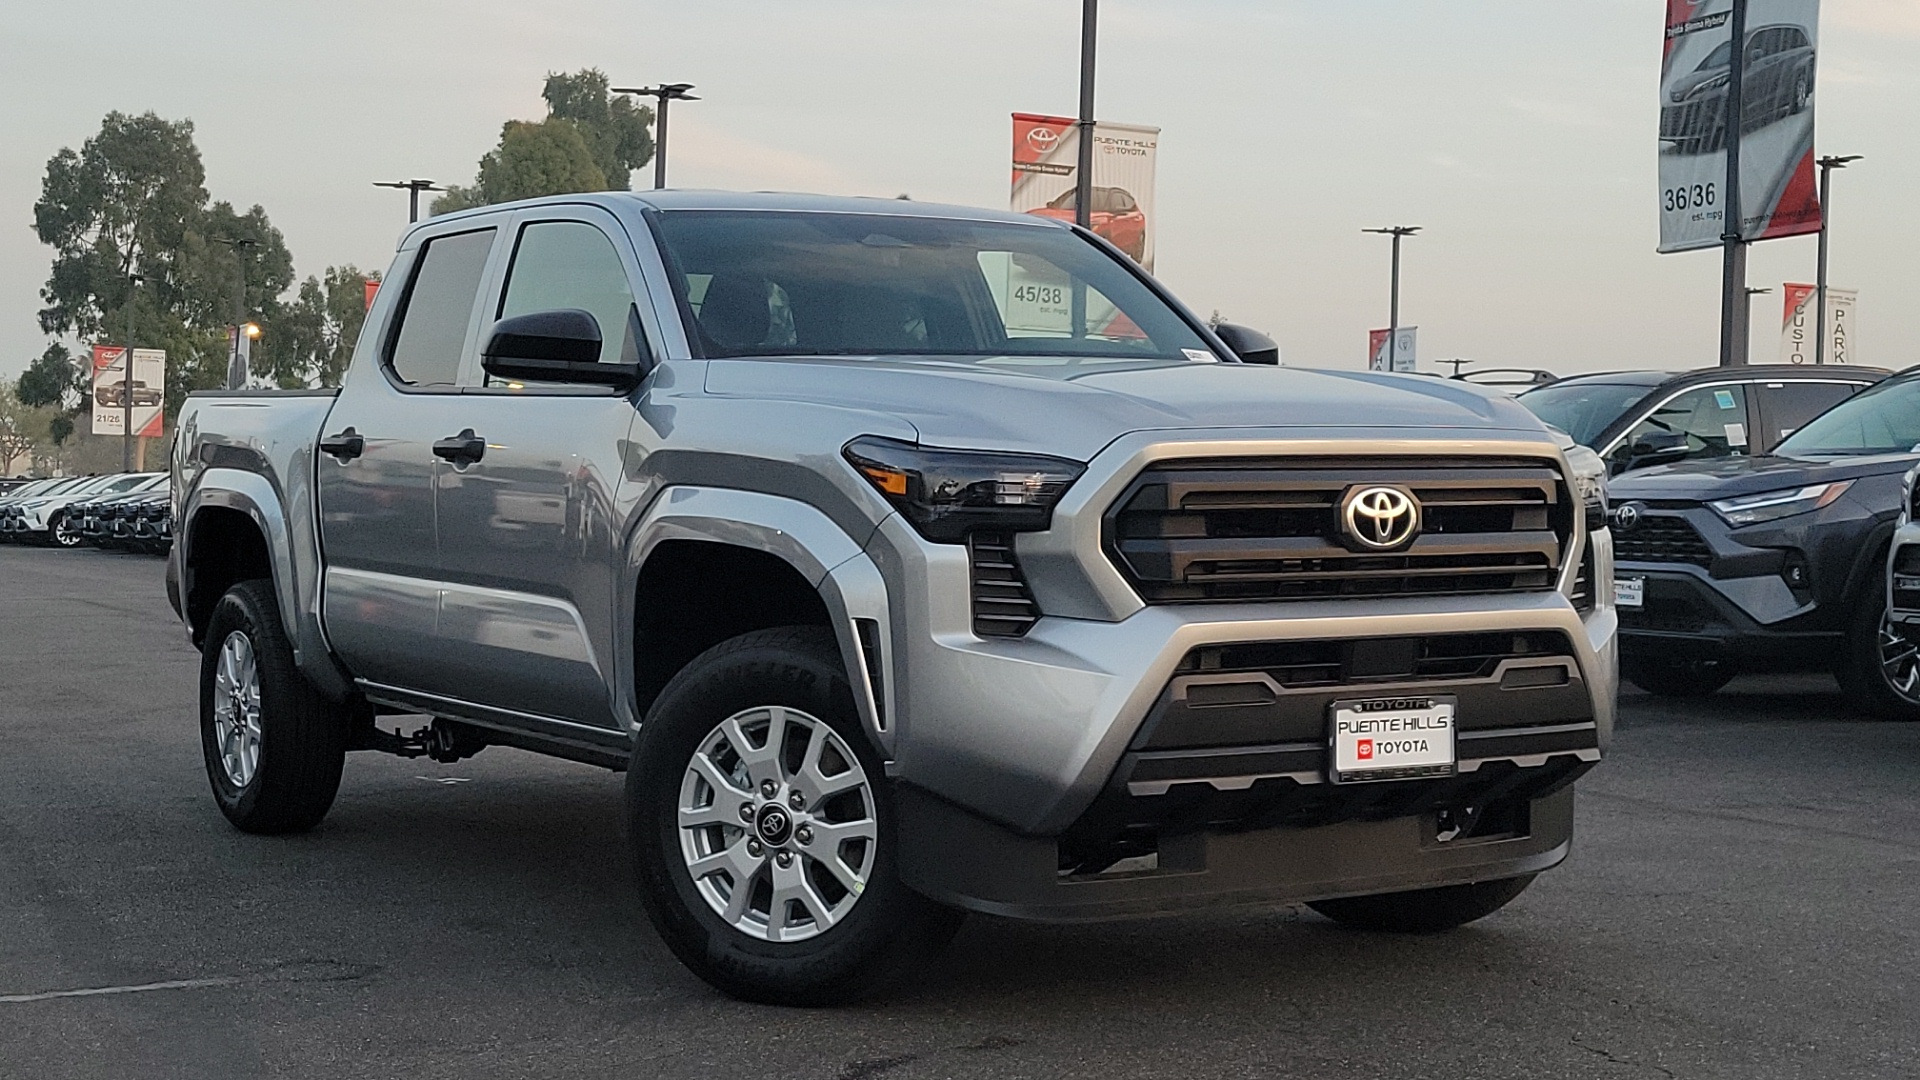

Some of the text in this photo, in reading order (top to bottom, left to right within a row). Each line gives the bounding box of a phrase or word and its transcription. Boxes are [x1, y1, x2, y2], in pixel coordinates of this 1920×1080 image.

[1116, 147, 1147, 157] TOYOTA
[1664, 182, 1716, 212] 36/36
[1014, 285, 1062, 305] 45/38
[1833, 309, 1846, 364] PARK
[1362, 699, 1428, 711] TOYOTA
[1338, 716, 1448, 735] PUENTE HILLS
[1376, 739, 1429, 755] TOYOTA
